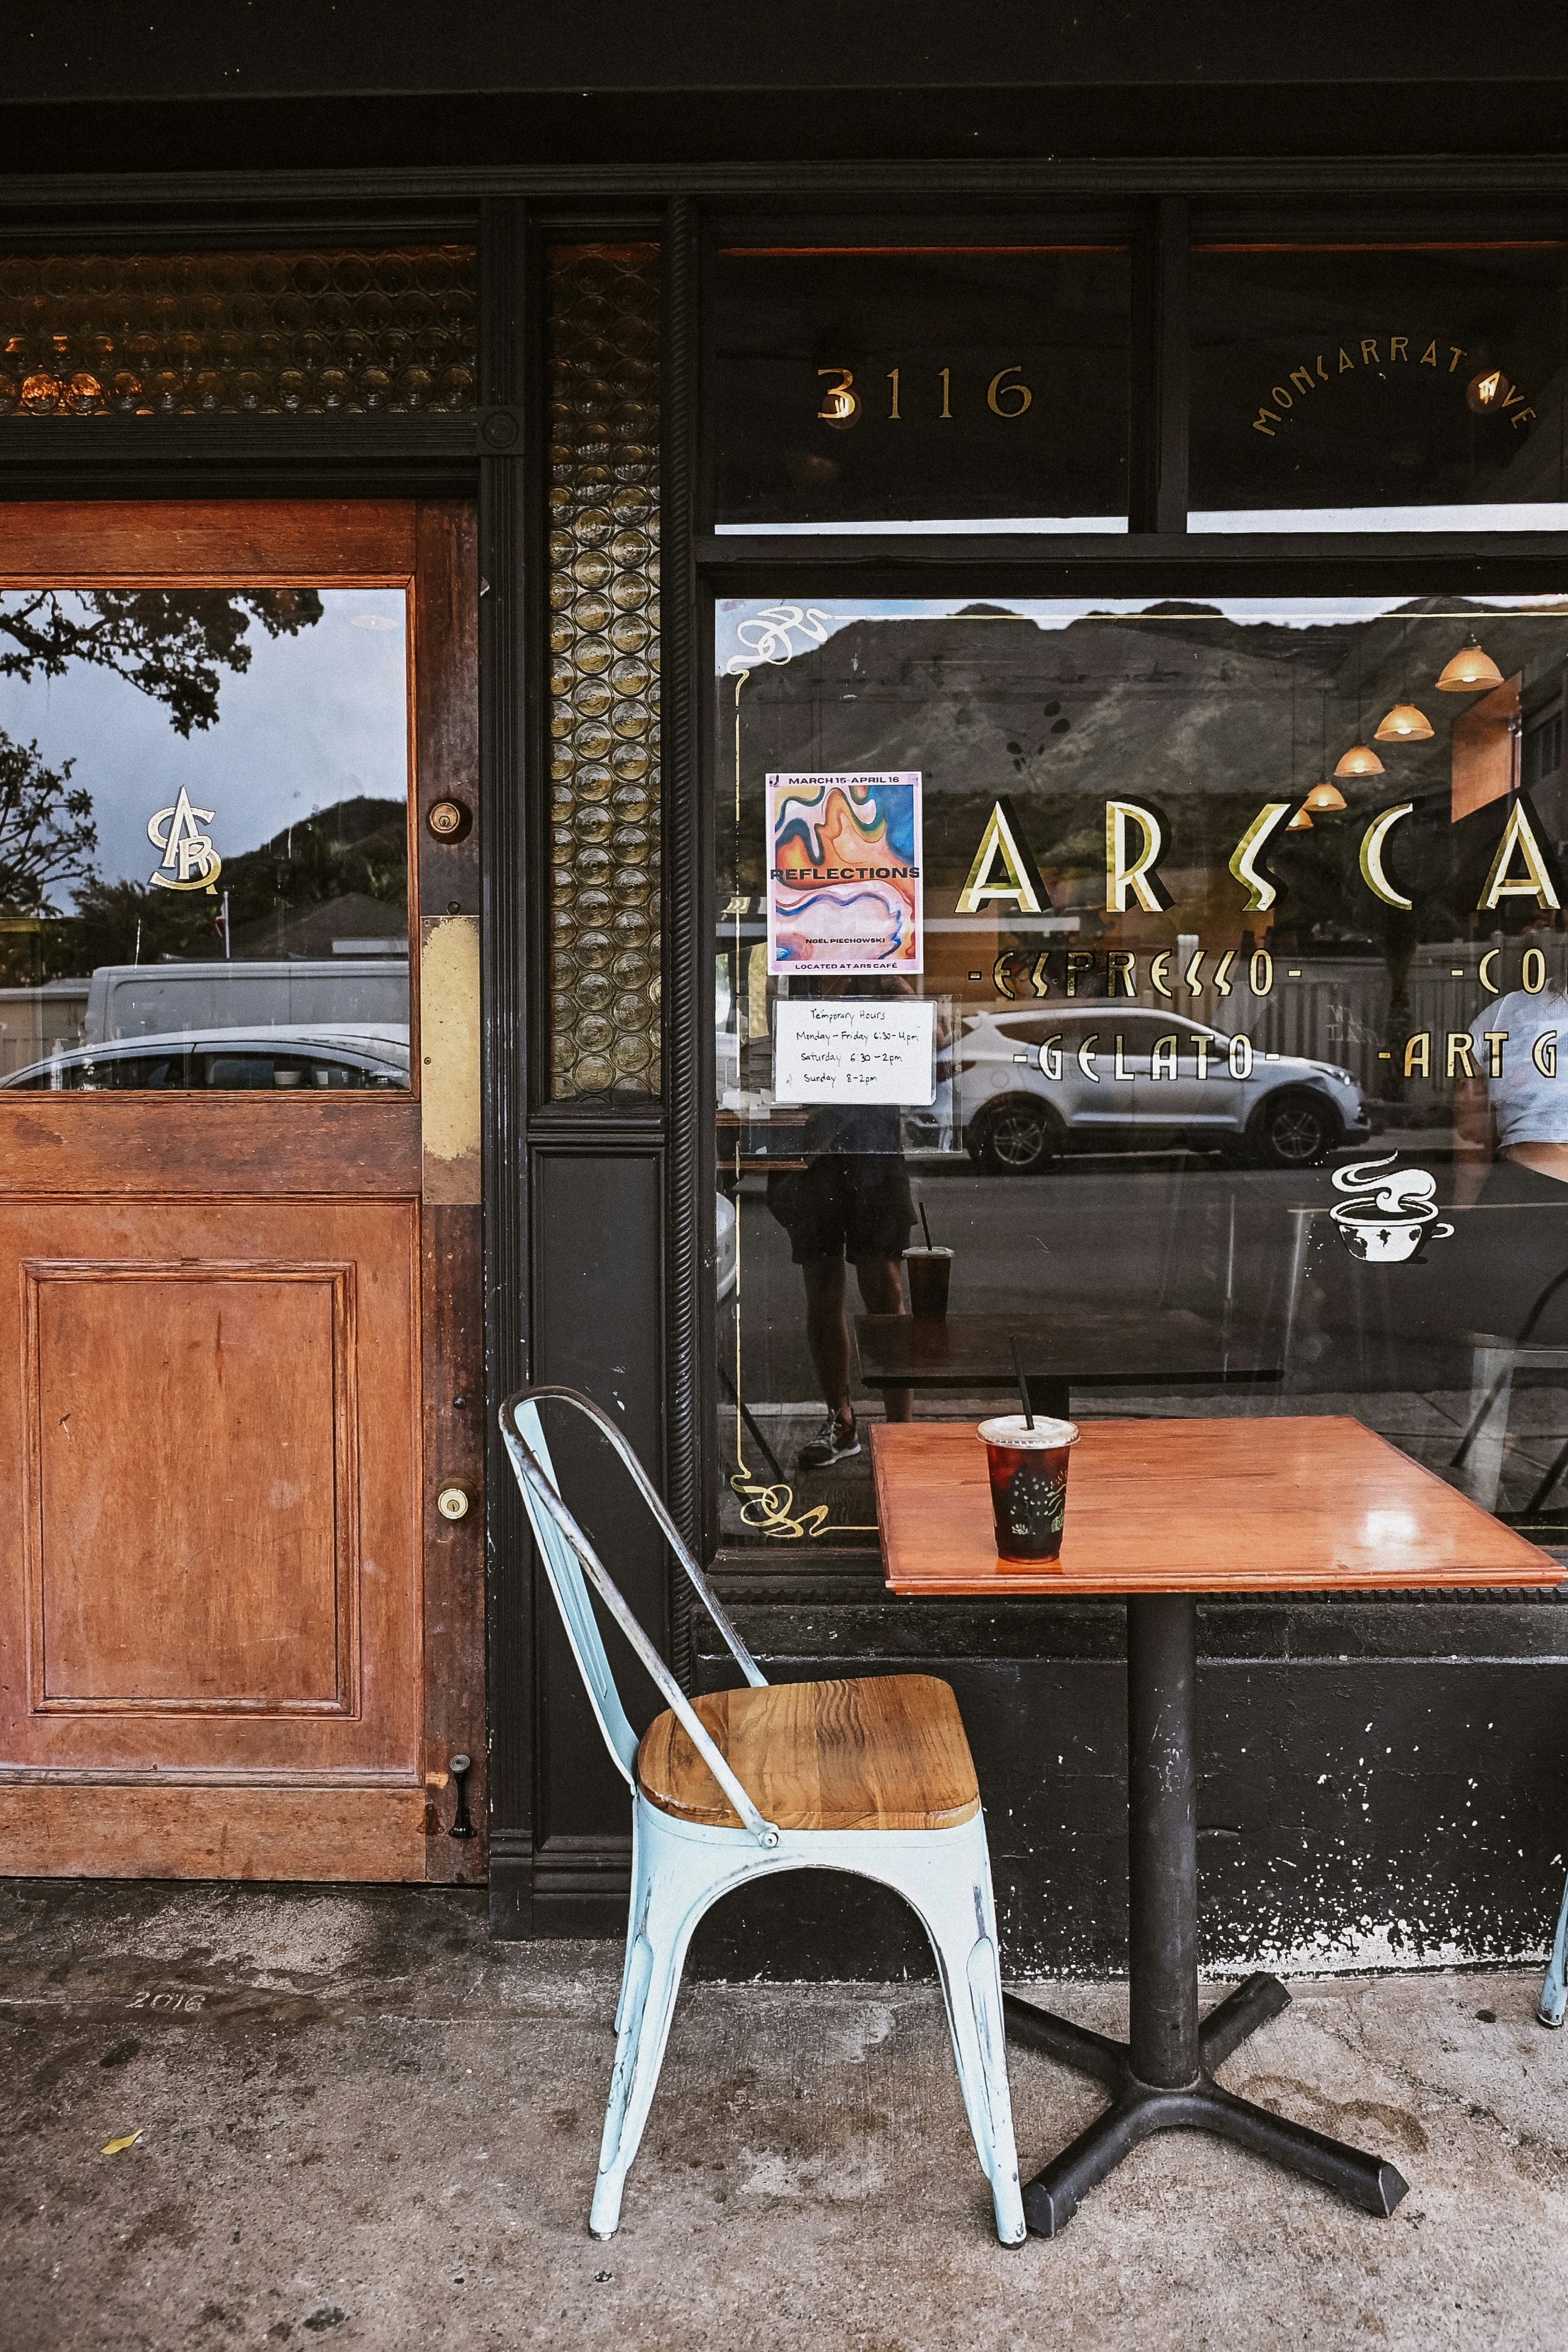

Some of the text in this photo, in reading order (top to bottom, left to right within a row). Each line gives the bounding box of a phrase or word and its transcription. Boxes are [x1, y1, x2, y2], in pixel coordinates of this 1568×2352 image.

[817, 366, 1032, 419] 3116
[1252, 336, 1537, 436] MONSARRAT AVE
[770, 867, 920, 879] REFLECTIONS
[810, 1008, 886, 1025] Temporary Hours
[800, 1052, 842, 1067] Saturday
[803, 1072, 836, 1088] Sunday
[125, 1991, 206, 2013] 2016
